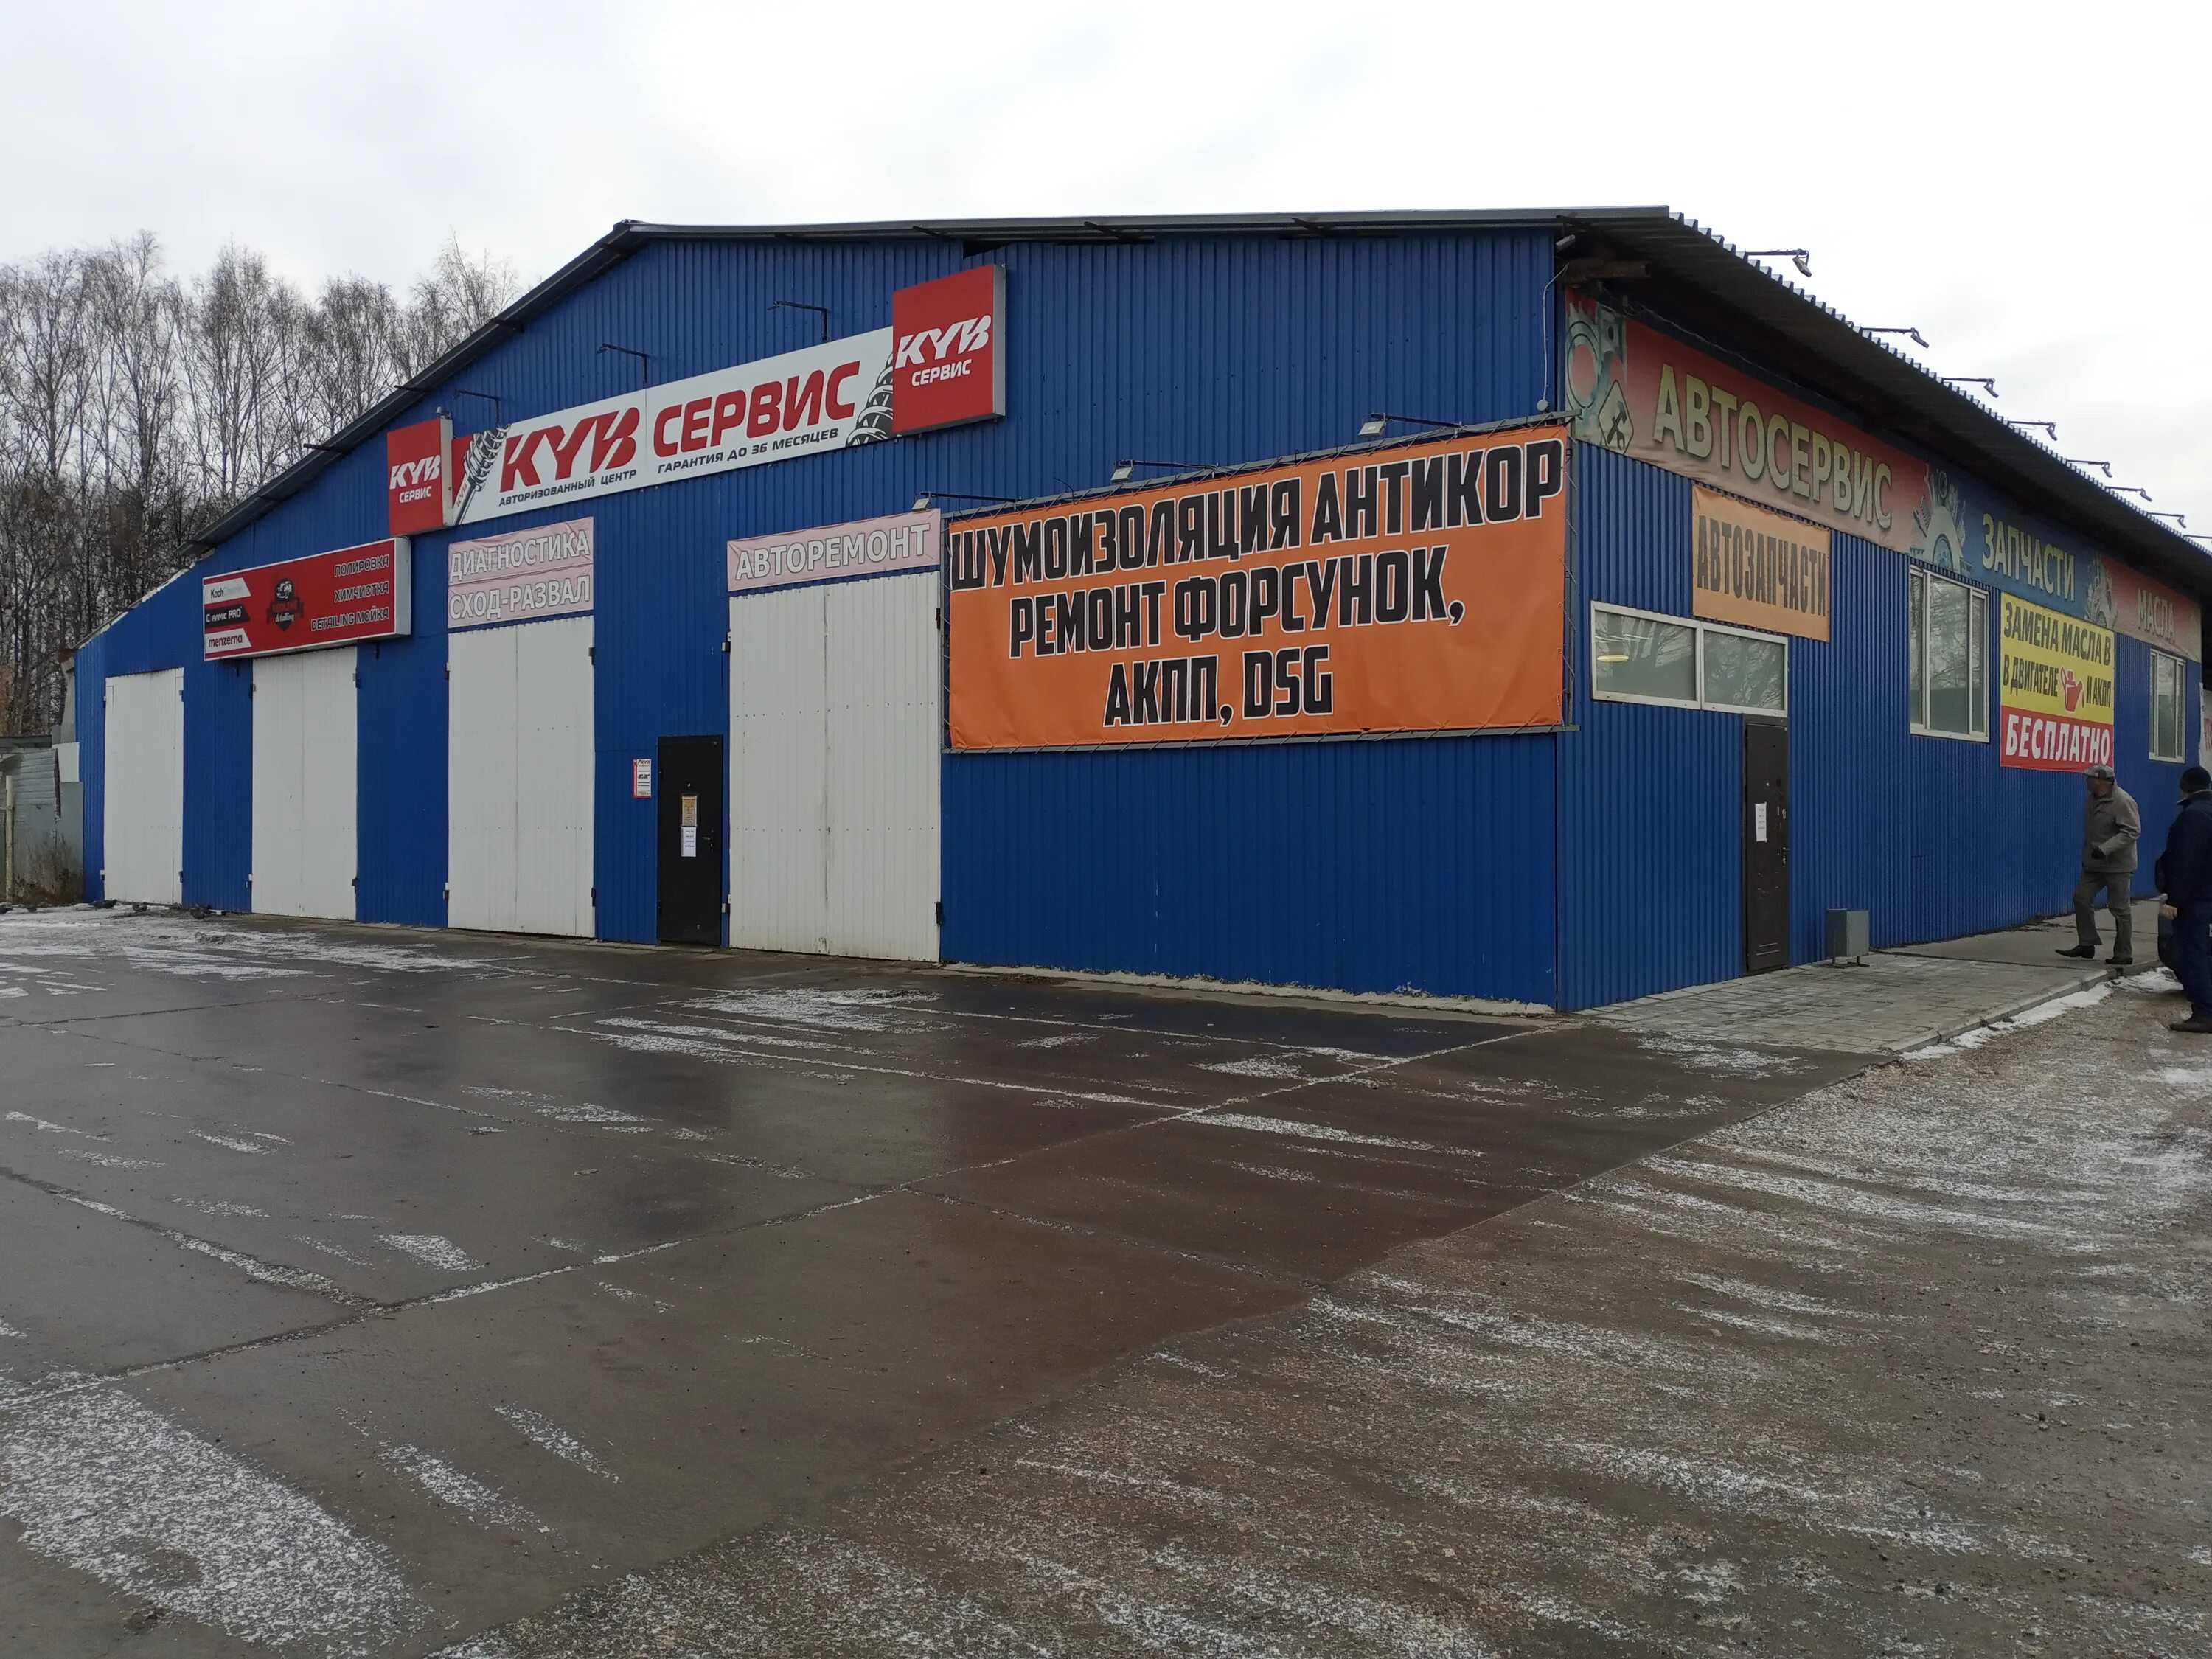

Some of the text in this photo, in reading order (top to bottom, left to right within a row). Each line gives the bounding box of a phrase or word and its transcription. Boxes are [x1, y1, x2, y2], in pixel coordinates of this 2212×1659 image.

[895, 315, 991, 369] KYB
[911, 358, 971, 386] СЕРВИС
[500, 361, 860, 493] KYB СЕРВИС
[658, 452, 723, 474] ГАРАНТИЯ
[726, 446, 748, 462] ДО
[772, 428, 838, 451] МЕСЯЦЕВ
[1652, 364, 1892, 529] АВТОСЕРВИС
[389, 455, 441, 490] KYB
[399, 486, 431, 503] СЕРВИС
[499, 469, 636, 507] АВТОРИЗОВАННЫЙ ЦЕНТР
[950, 438, 1565, 592] ШУМОИЗОЛЯЦИЯ АНТИКОР
[334, 554, 389, 577] ПОЛИРОВКА
[449, 530, 589, 582] ДИАГНОСТИКА
[735, 523, 931, 581] АВТОРЕМОНТ
[1697, 515, 1826, 617] АВТОЗАПЧАСТИ
[1982, 513, 2075, 602] ЗАПЧАСТИ
[206, 608, 241, 622] CRAMIC PRO
[334, 581, 389, 602] ХИМЧИСТКА
[449, 575, 589, 620] СХОД-РАЗВАЛ
[1009, 544, 1466, 659] РЕМОНТ ФОРСУНОК,
[2138, 587, 2175, 643] МАСЛА
[209, 634, 243, 647] menzerna
[311, 605, 389, 631] DETAILING МОЙКА
[2003, 602, 2111, 666] ЗАМЕНА МАСЛА В
[1102, 644, 1333, 728] АКПП, DSG
[2003, 654, 2111, 708] В ДВИГАТЕЛЕ И АКПП
[2006, 714, 2110, 765] БЕСПЛАТНО
